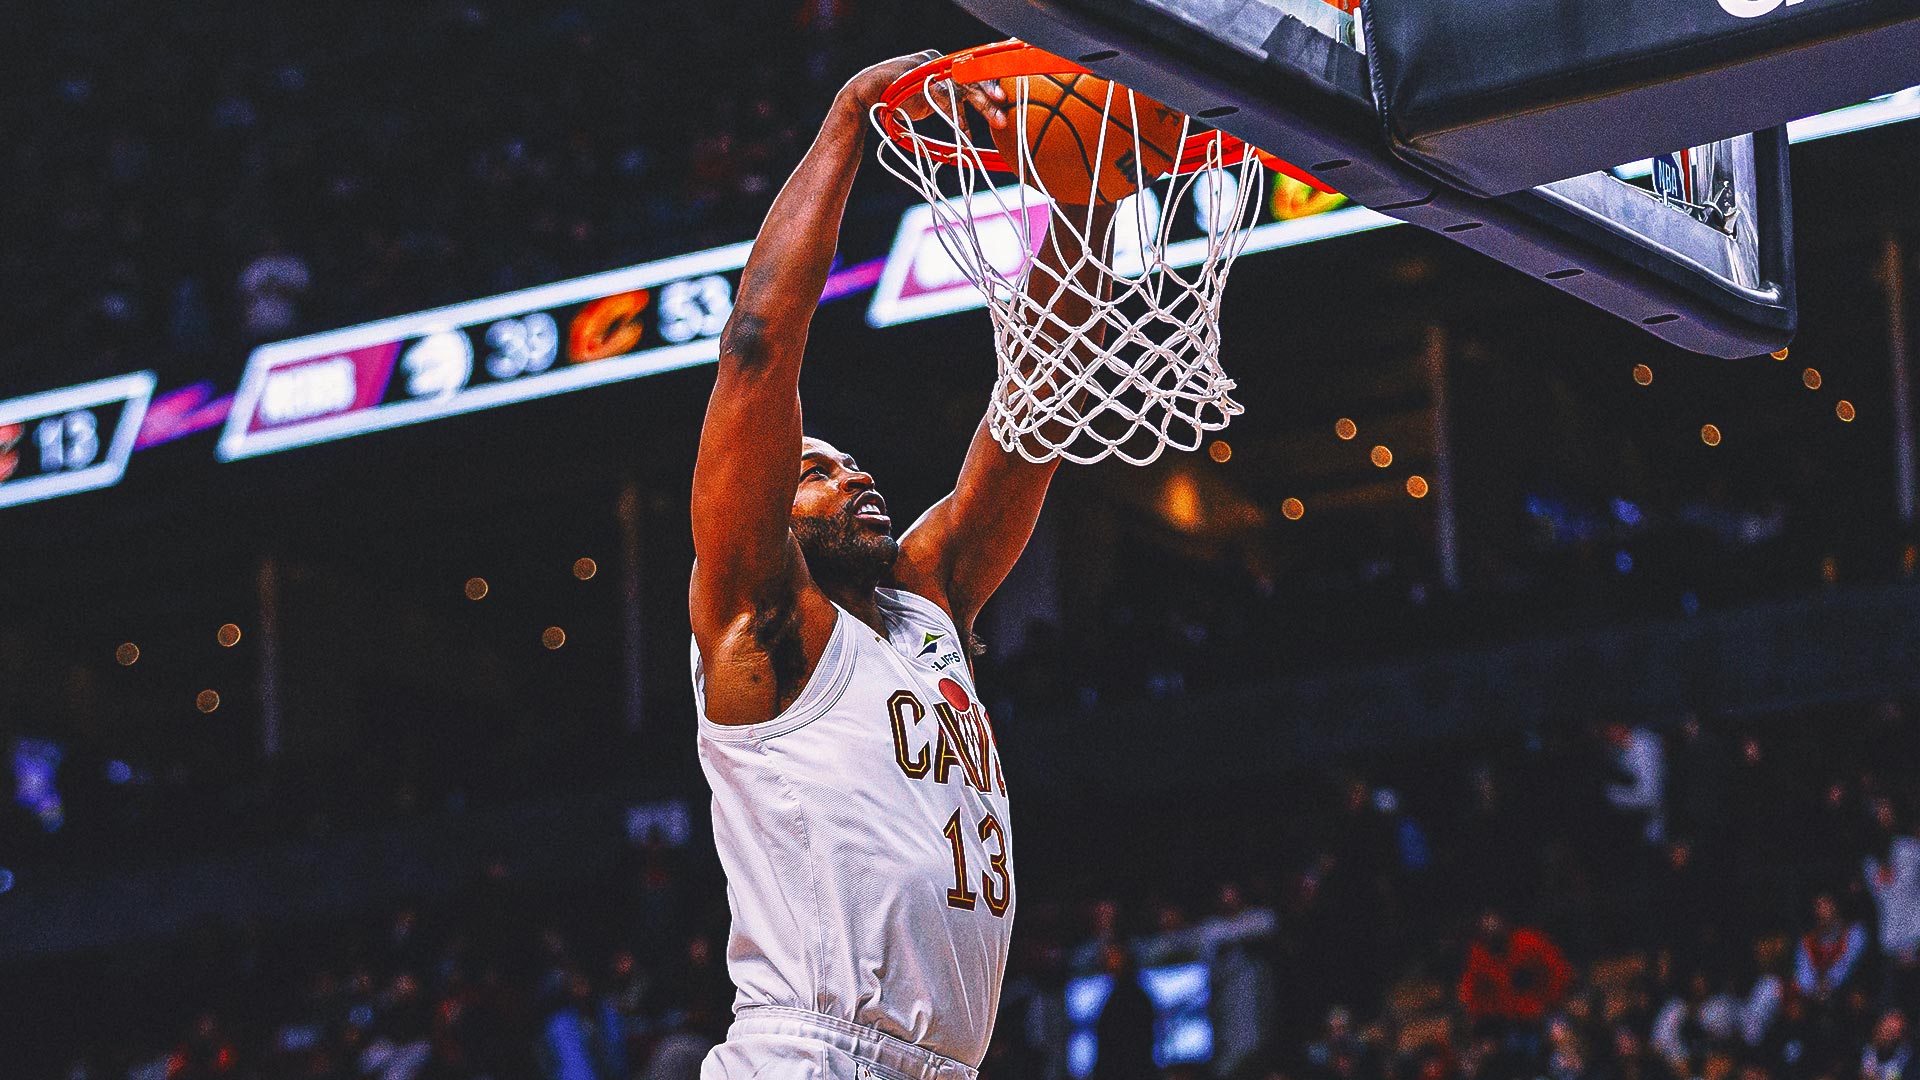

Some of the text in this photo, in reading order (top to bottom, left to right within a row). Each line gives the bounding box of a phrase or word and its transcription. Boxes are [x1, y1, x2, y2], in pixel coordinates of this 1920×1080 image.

[1658, 159, 1678, 197] NBA
[33, 409, 99, 472] 13
[943, 807, 1010, 918] 13
